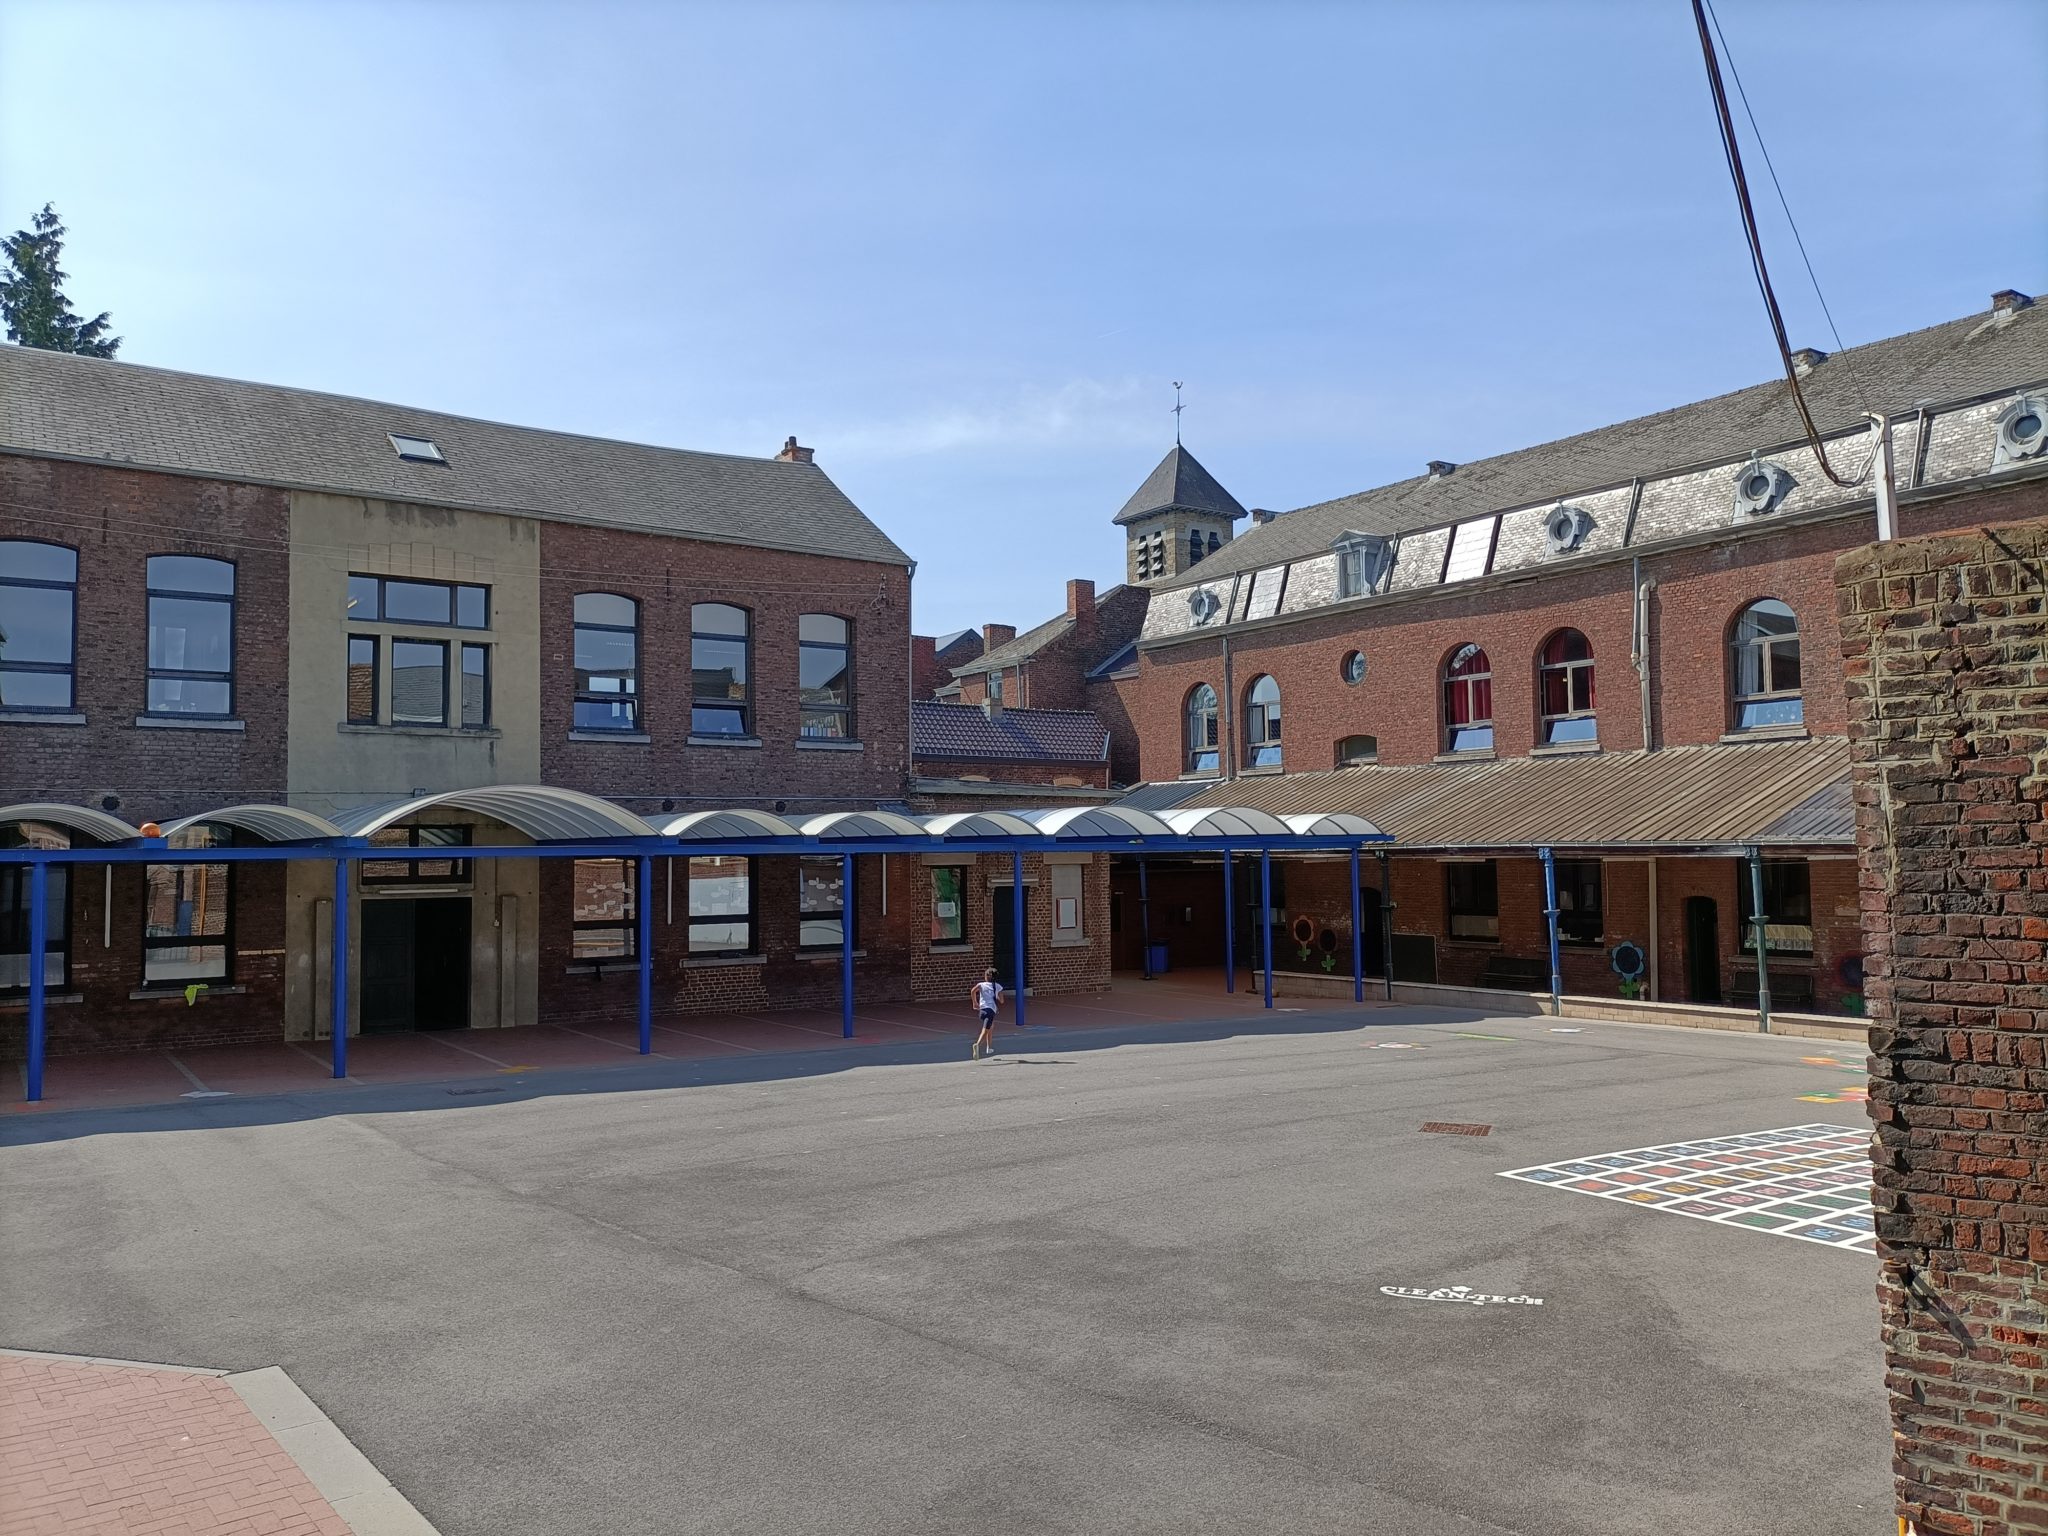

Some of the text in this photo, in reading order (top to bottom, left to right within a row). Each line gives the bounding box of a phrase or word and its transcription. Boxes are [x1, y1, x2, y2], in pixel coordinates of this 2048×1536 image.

[1792, 1180, 1822, 1188] 67
[1720, 1195, 1754, 1204] 69
[1680, 1204, 1718, 1212] 70
[1803, 1228, 1842, 1239] 50
